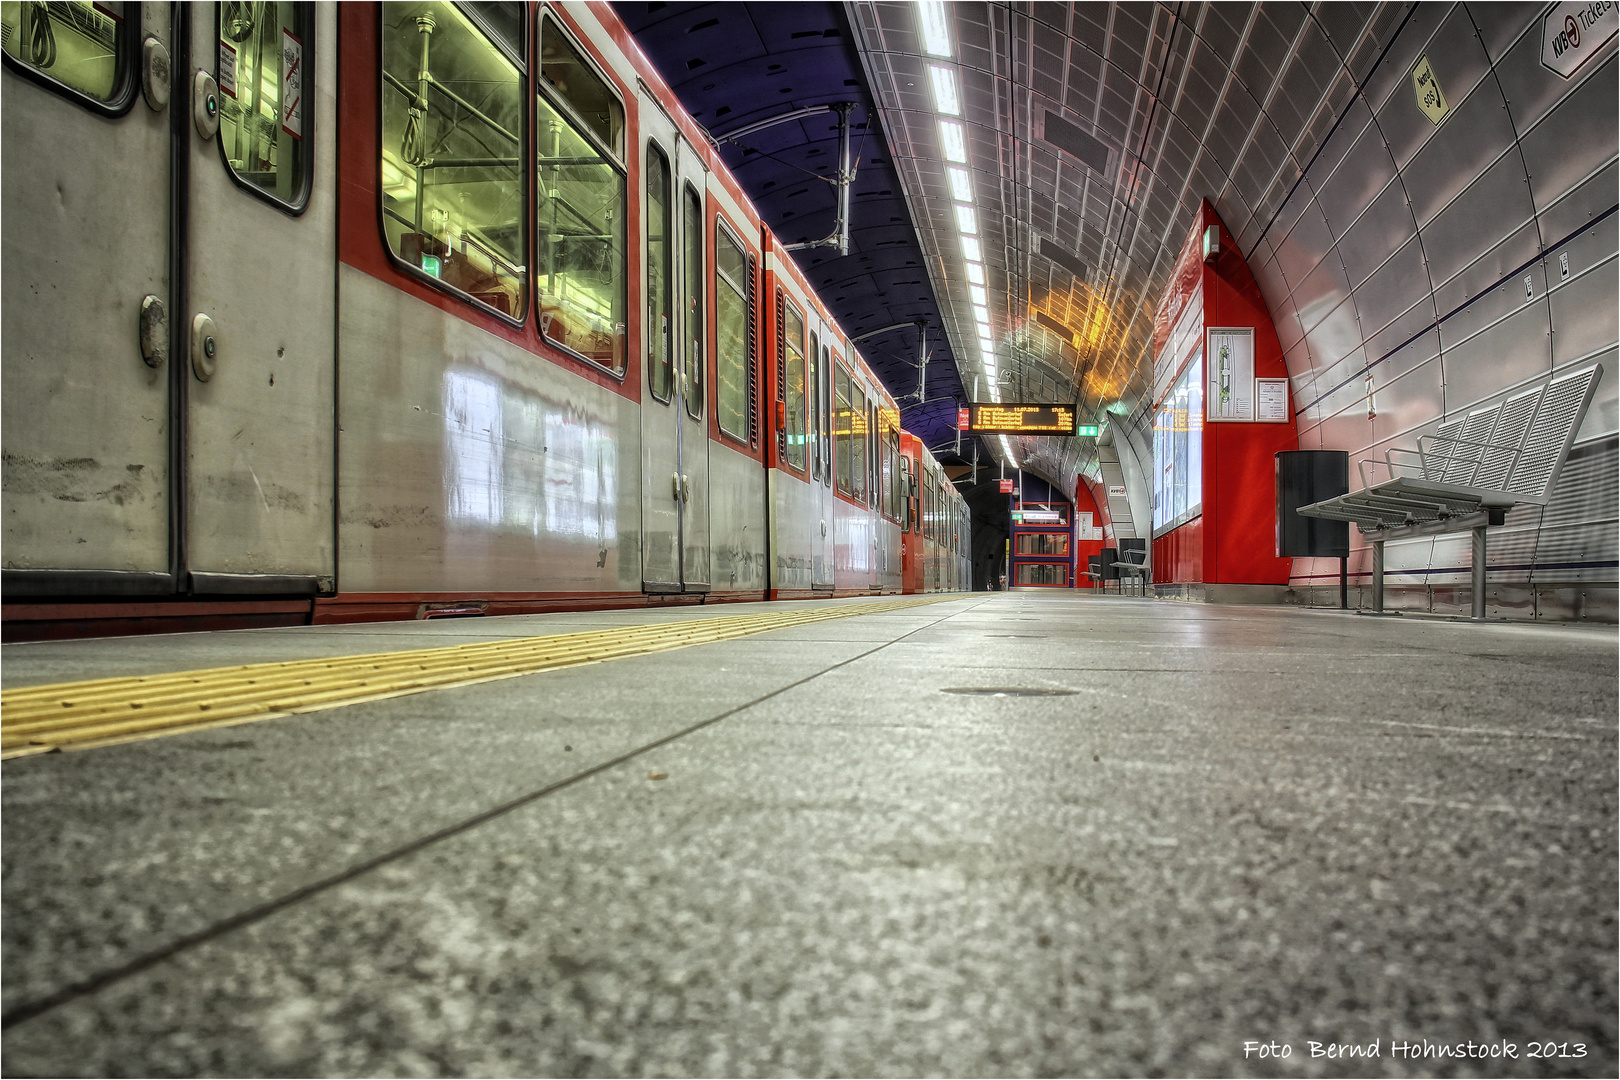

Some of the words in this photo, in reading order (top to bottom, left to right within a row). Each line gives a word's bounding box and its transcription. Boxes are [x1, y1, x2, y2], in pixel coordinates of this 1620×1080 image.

[1551, 30, 1569, 59] KVB
[1577, 1, 1612, 31] Tickets
[1416, 65, 1432, 88] Notruf
[1424, 90, 1436, 108] SOS
